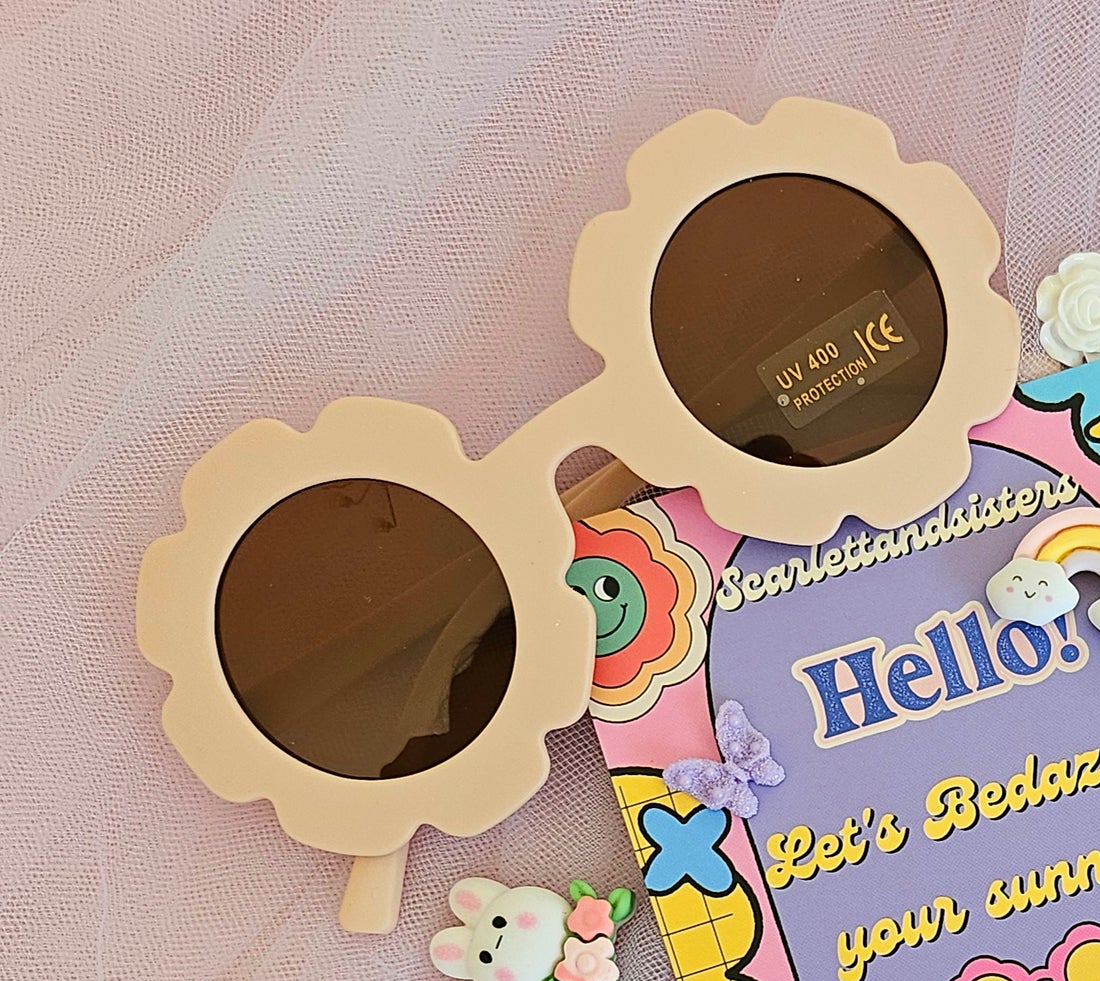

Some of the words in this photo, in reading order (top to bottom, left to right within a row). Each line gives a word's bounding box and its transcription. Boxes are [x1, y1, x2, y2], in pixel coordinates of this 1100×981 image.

[775, 361, 804, 390] UV
[807, 342, 840, 371] 400
[865, 312, 904, 352] CE
[793, 356, 868, 412] PROTECTION
[716, 474, 1083, 613] Scarlettandsisters
[801, 610, 1081, 741] Hello!
[765, 807, 909, 890] Let's
